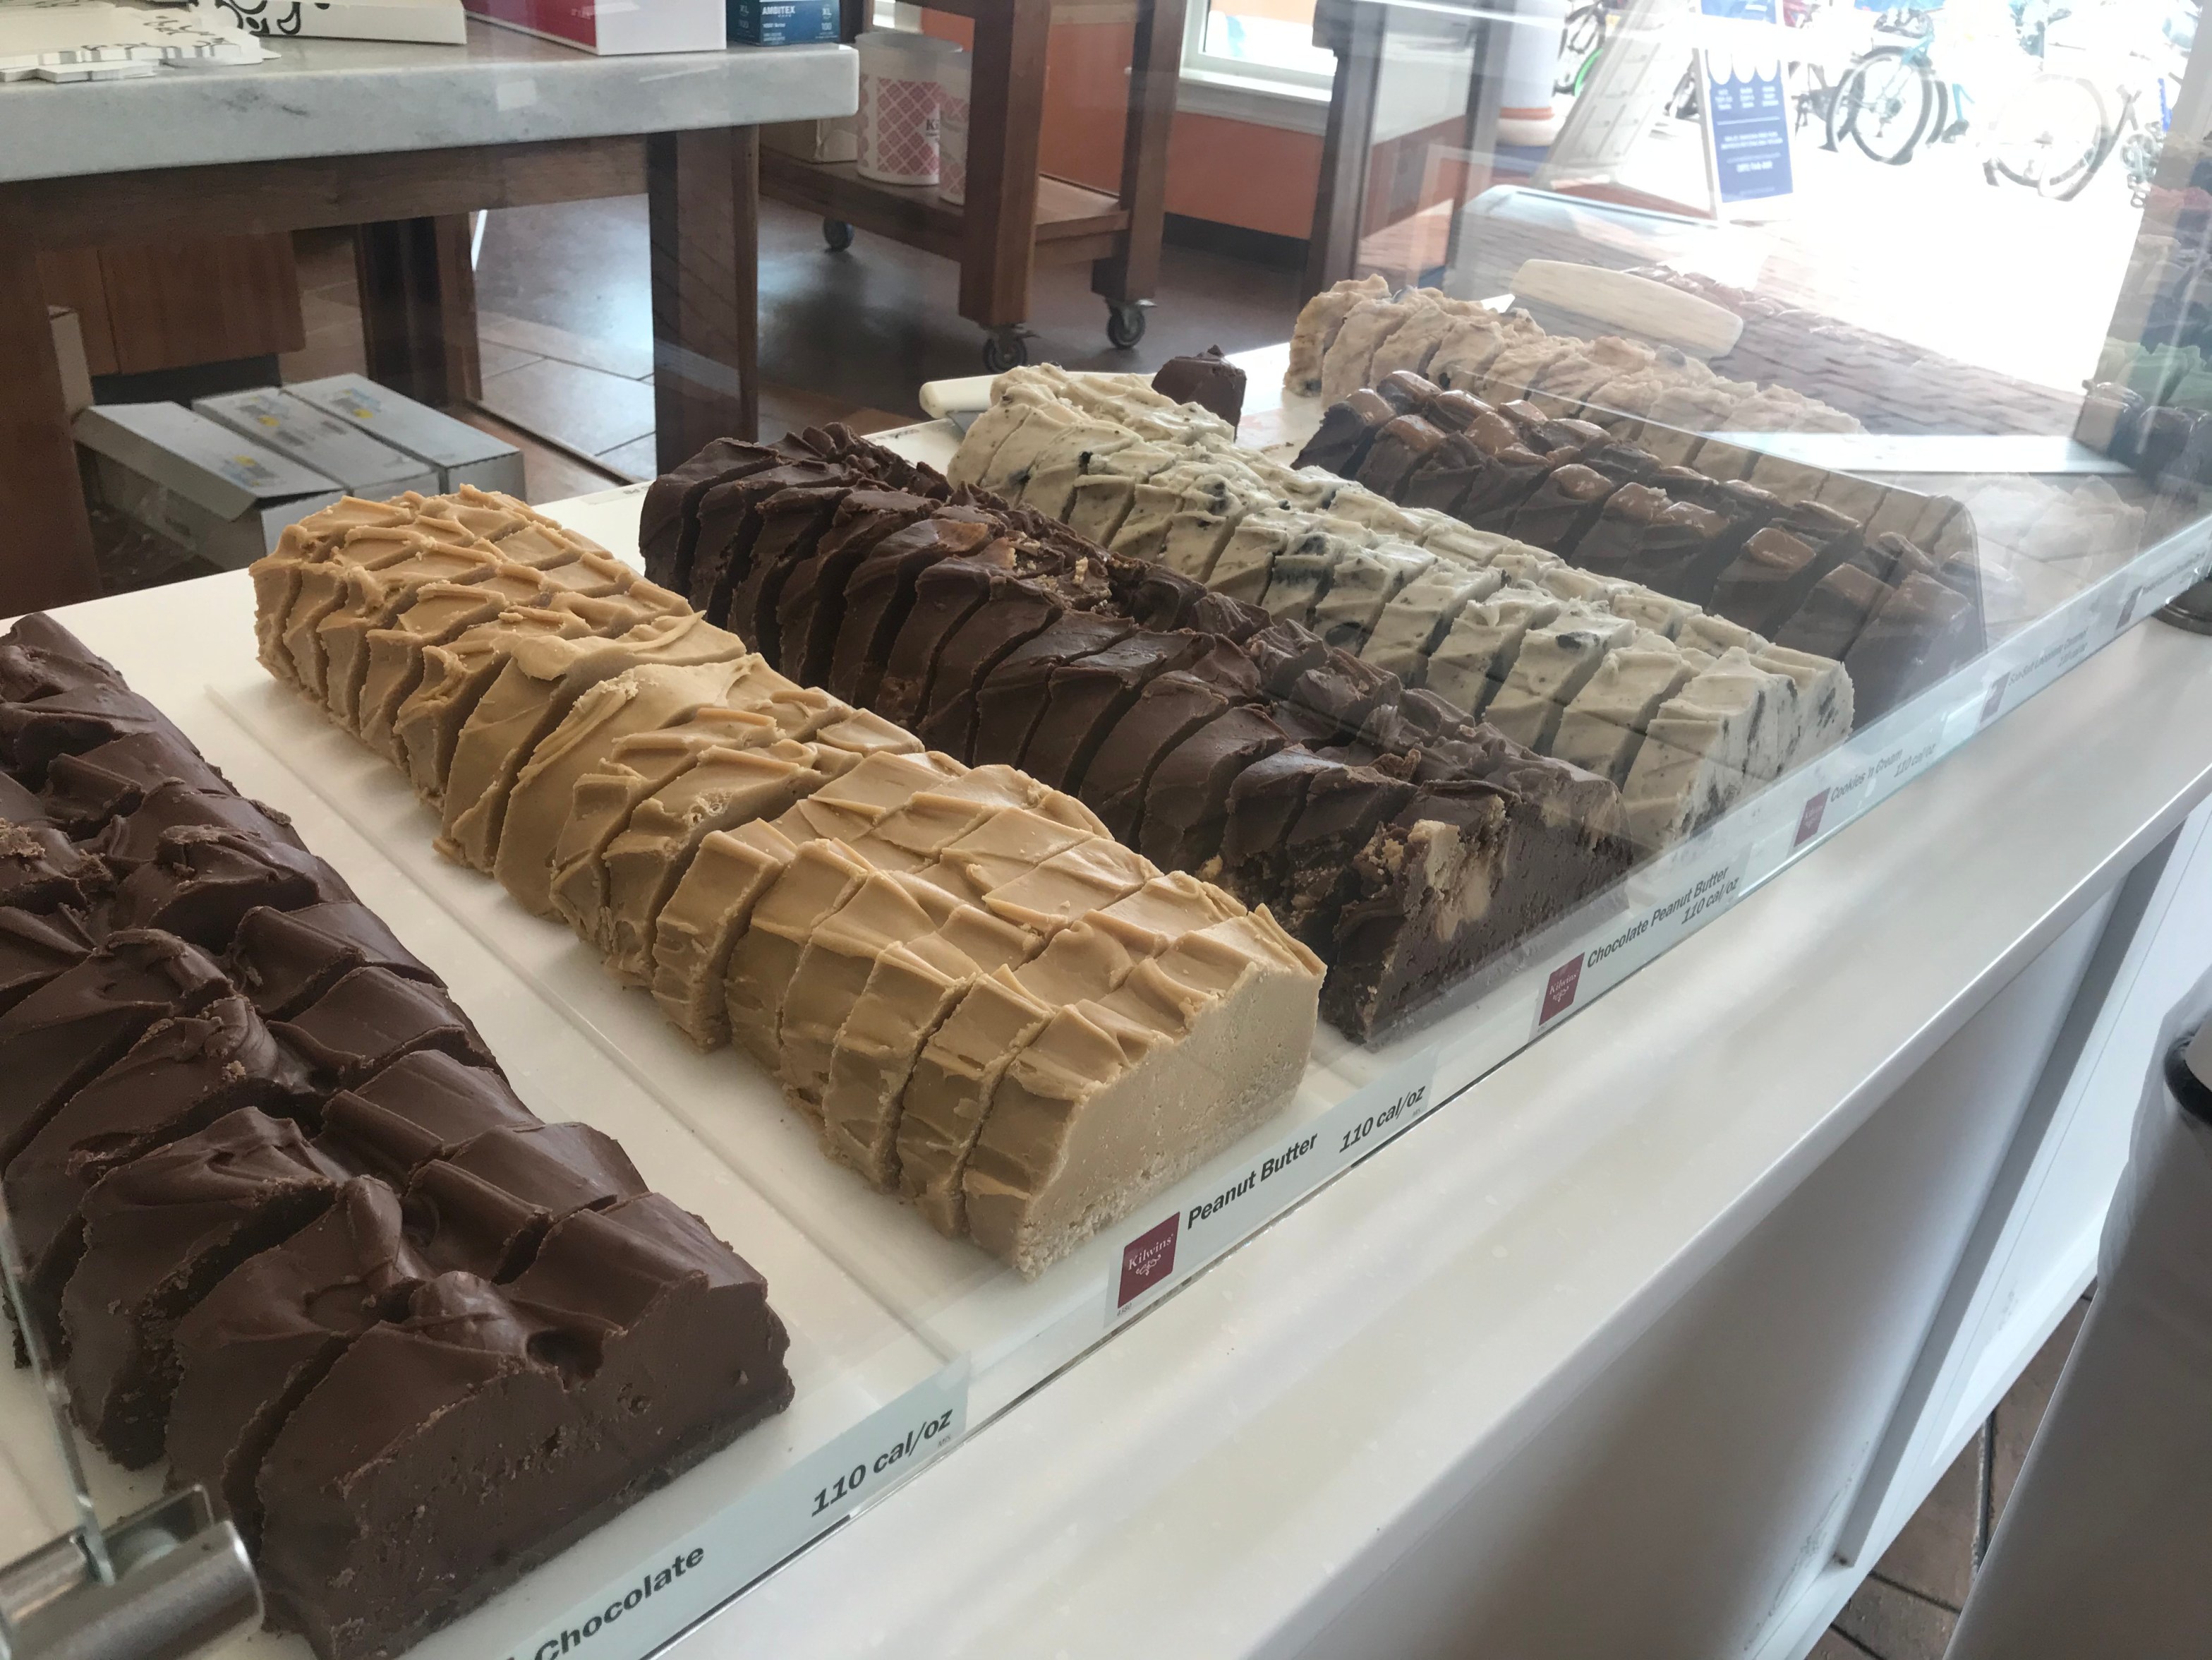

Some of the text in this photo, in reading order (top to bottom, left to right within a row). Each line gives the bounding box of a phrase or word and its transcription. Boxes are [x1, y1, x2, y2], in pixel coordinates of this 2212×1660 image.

[762, 6, 796, 16] AMBITEX
[1830, 772, 1866, 802] Cookies
[1875, 748, 1903, 774] Cream
[1893, 755, 1912, 778] 110
[1587, 866, 1729, 968] Chocolate Peanut Butter
[1681, 877, 1739, 925] 110 cal/oz
[1549, 973, 1578, 995] Kilwins
[1187, 1085, 1426, 1231] Peanut Butter 110 cal/oz
[1128, 1236, 1173, 1271] Kilwins
[533, 1408, 954, 1660] Chocolate 110 cal/oz
